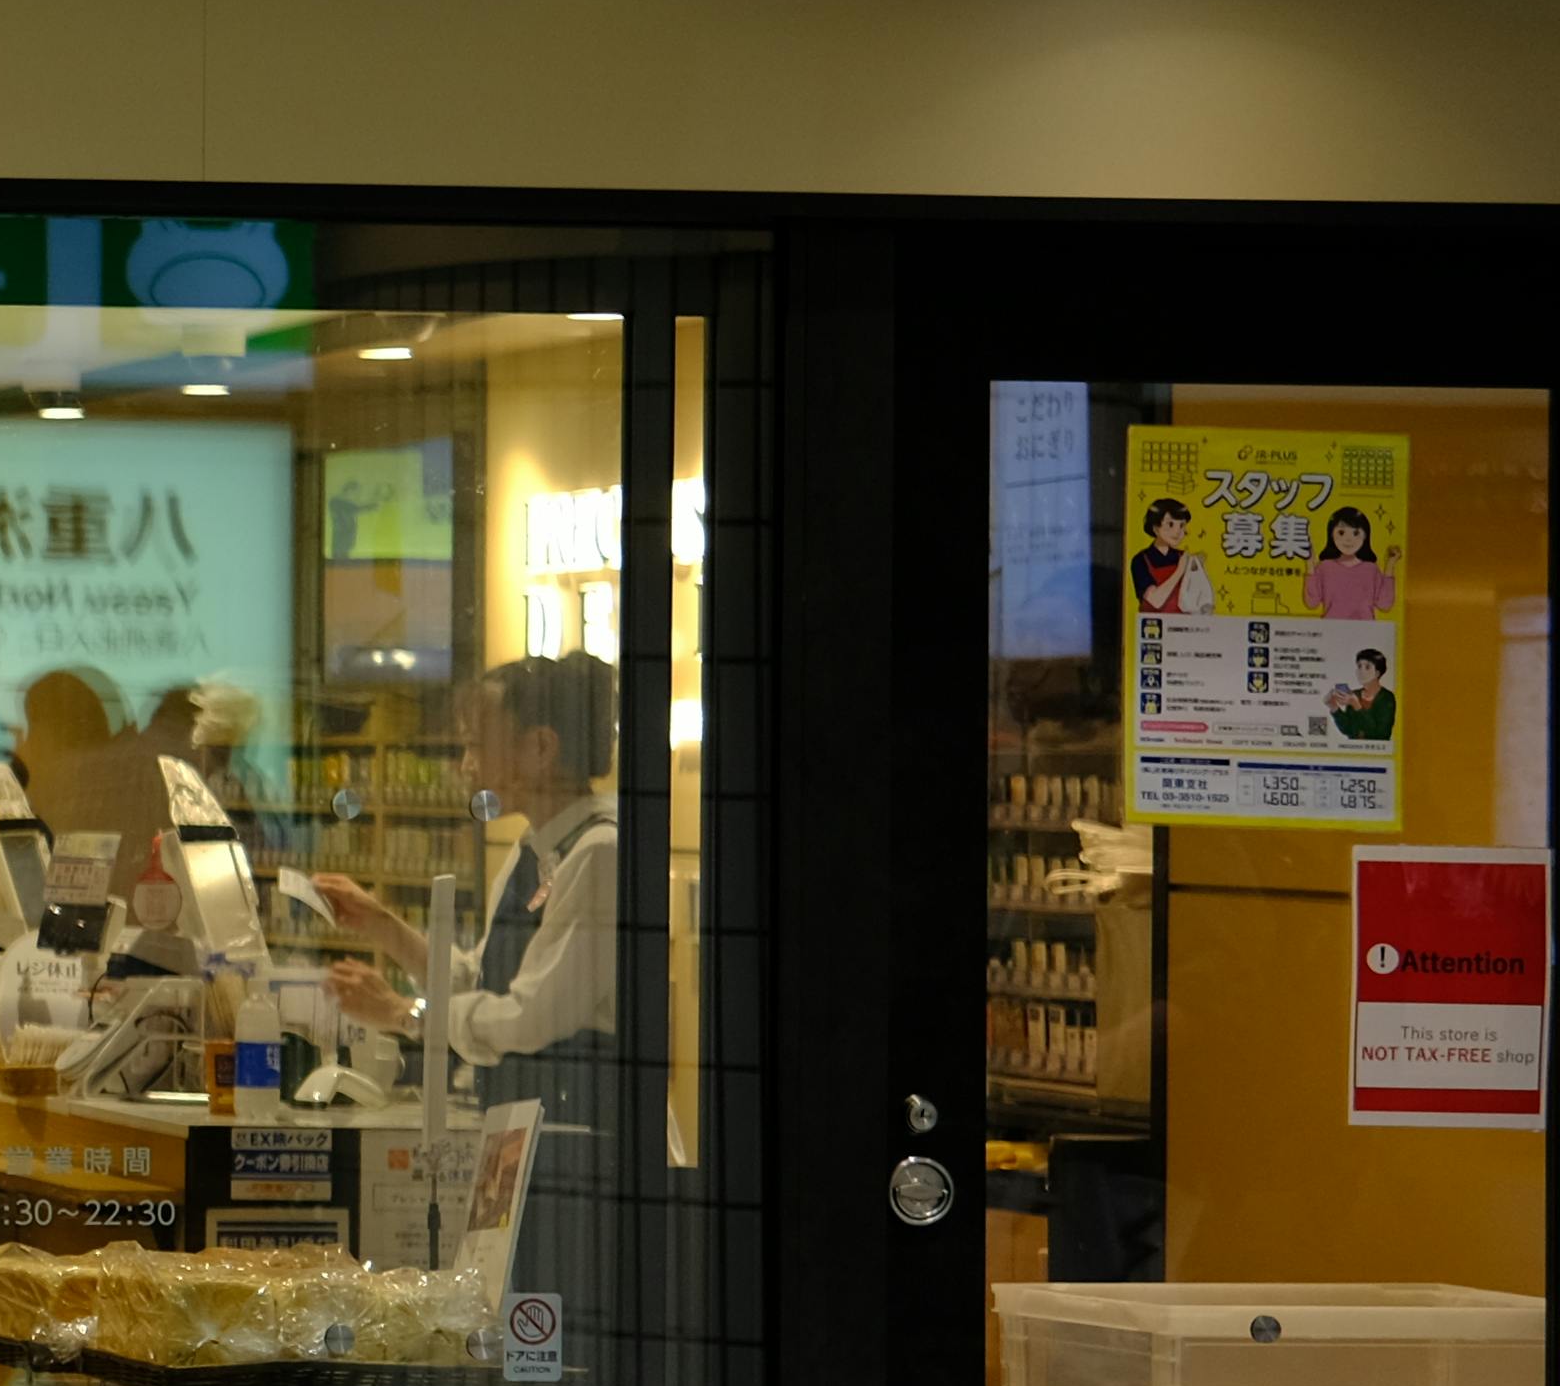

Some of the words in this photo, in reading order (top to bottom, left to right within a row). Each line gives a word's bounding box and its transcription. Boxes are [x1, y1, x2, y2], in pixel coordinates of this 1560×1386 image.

[1203, 470, 1333, 510] スタッフ
[1222, 512, 1312, 560] 募集
[1141, 791, 1160, 801] TEL
[1401, 949, 1525, 975] Attention
[1401, 1025, 1433, 1040] This
[1439, 1028, 1479, 1042] store
[1485, 1028, 1497, 1042] is
[1362, 1046, 1398, 1061] NOT
[1405, 1047, 1491, 1062] TAX-FREE
[1497, 1049, 1535, 1065] shop
[7, 1146, 150, 1176] 営業時間
[506, 1351, 558, 1363] ドアに注意
[513, 1366, 551, 1374] CAUTION
